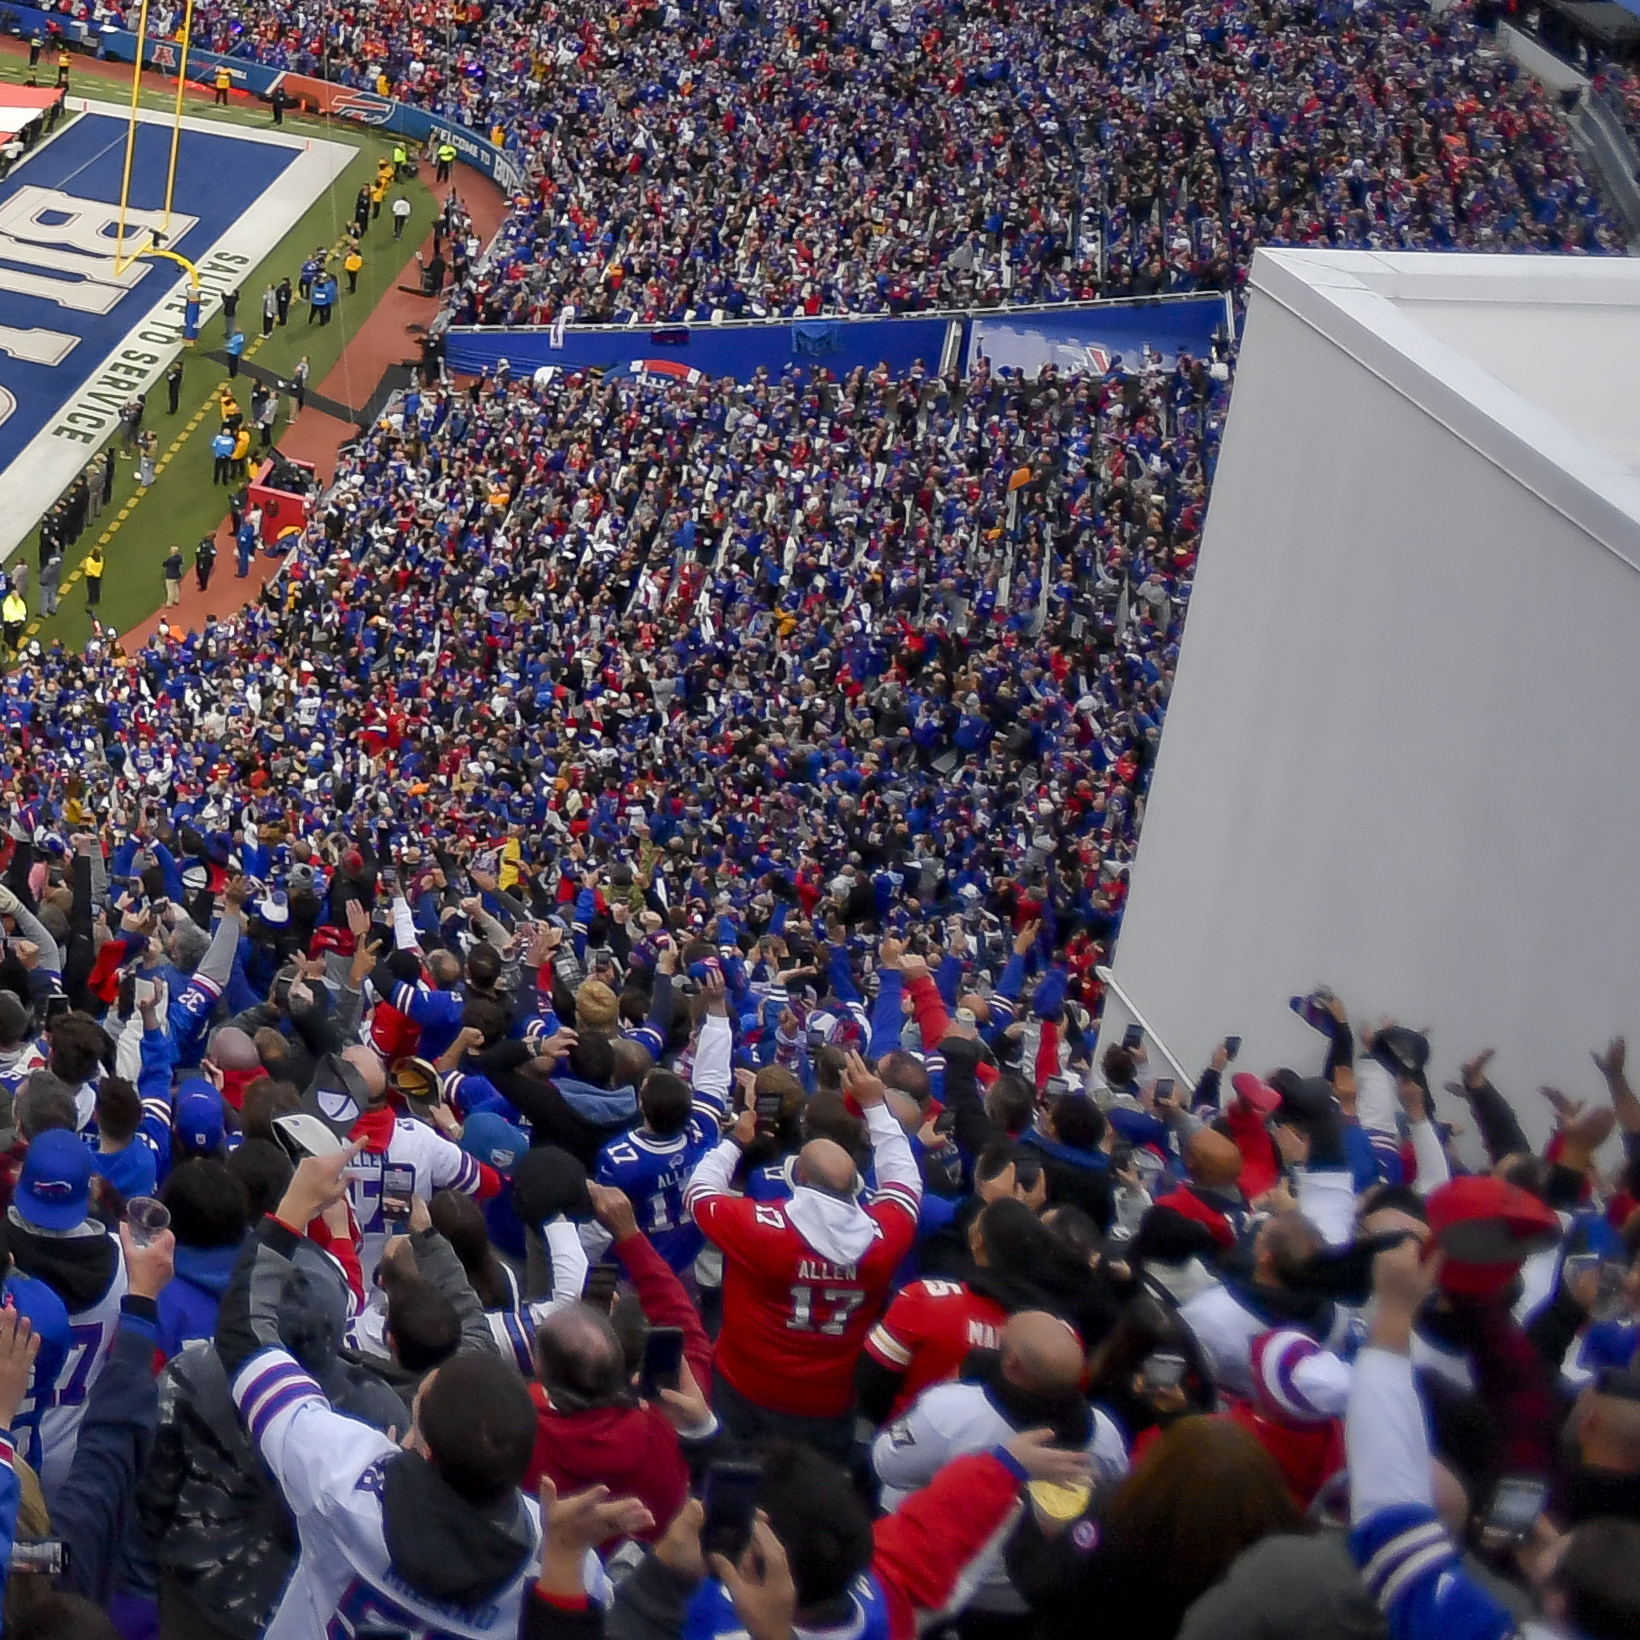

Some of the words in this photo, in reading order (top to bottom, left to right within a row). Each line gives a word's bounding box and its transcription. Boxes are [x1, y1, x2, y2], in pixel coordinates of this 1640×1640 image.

[138, 320, 184, 345] TO
[51, 349, 160, 446] SERVICE
[608, 1142, 639, 1164] 17
[756, 1205, 786, 1231] 17
[797, 1259, 857, 1283] ALLEN
[785, 1286, 868, 1337] 17
